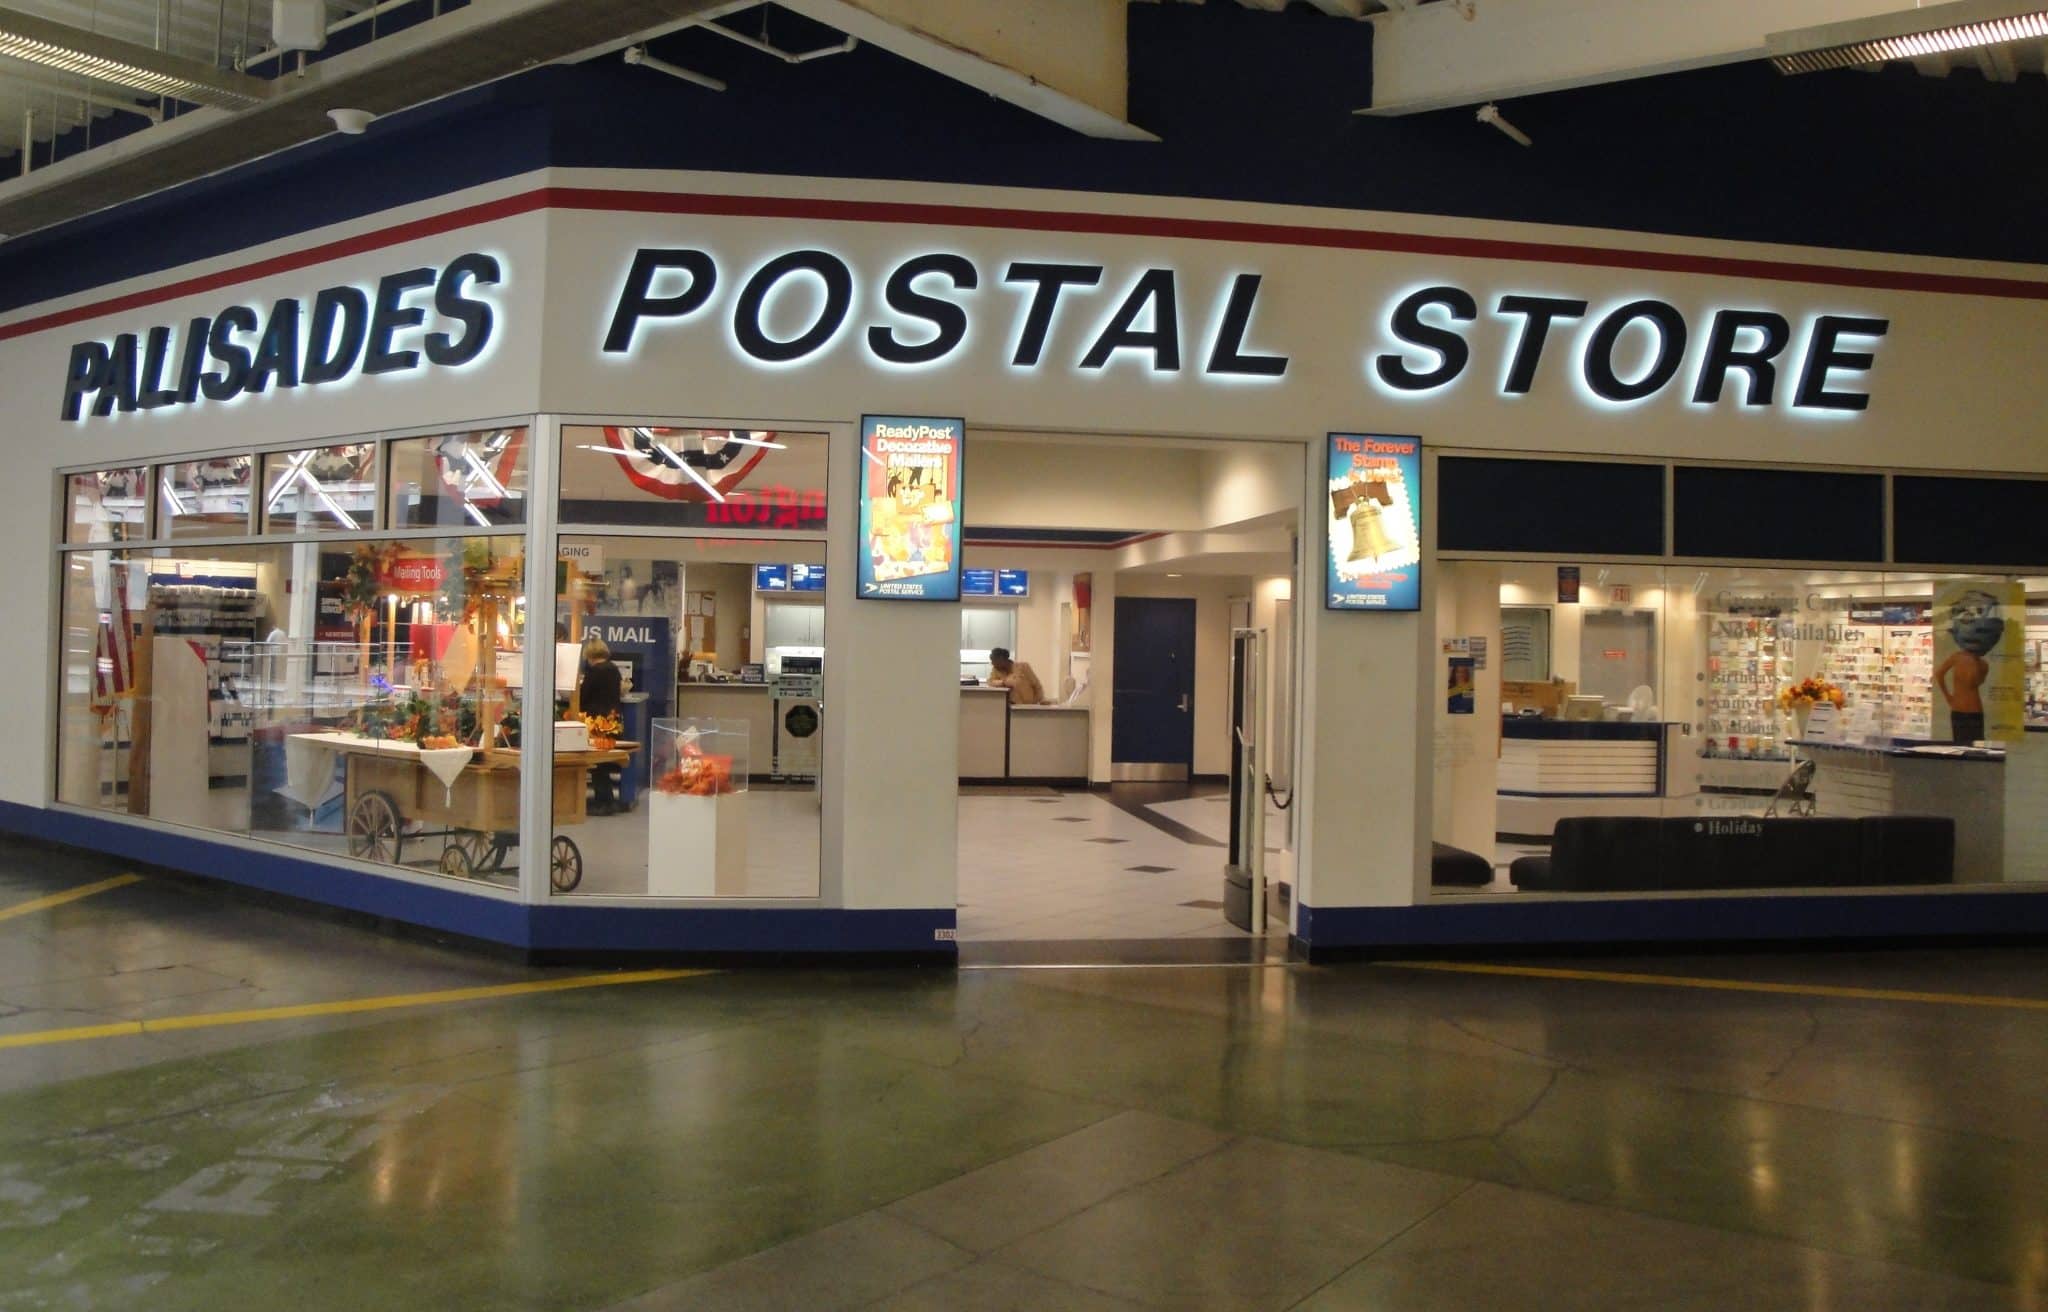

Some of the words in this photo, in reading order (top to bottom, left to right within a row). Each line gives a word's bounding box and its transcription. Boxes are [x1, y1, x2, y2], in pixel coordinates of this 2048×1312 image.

[61, 253, 500, 421] PALISADES
[602, 248, 1289, 376] POSTAL
[1375, 286, 1889, 410] STORE
[877, 438, 952, 454] Decorative
[1335, 437, 1361, 452] The
[1365, 438, 1415, 454] Forever
[1352, 453, 1398, 469] Stamp
[558, 547, 590, 557] GING
[394, 566, 421, 582] Mailing
[422, 566, 441, 580] Tools
[607, 626, 656, 643] MAIL
[1708, 821, 1763, 837] Holiday
